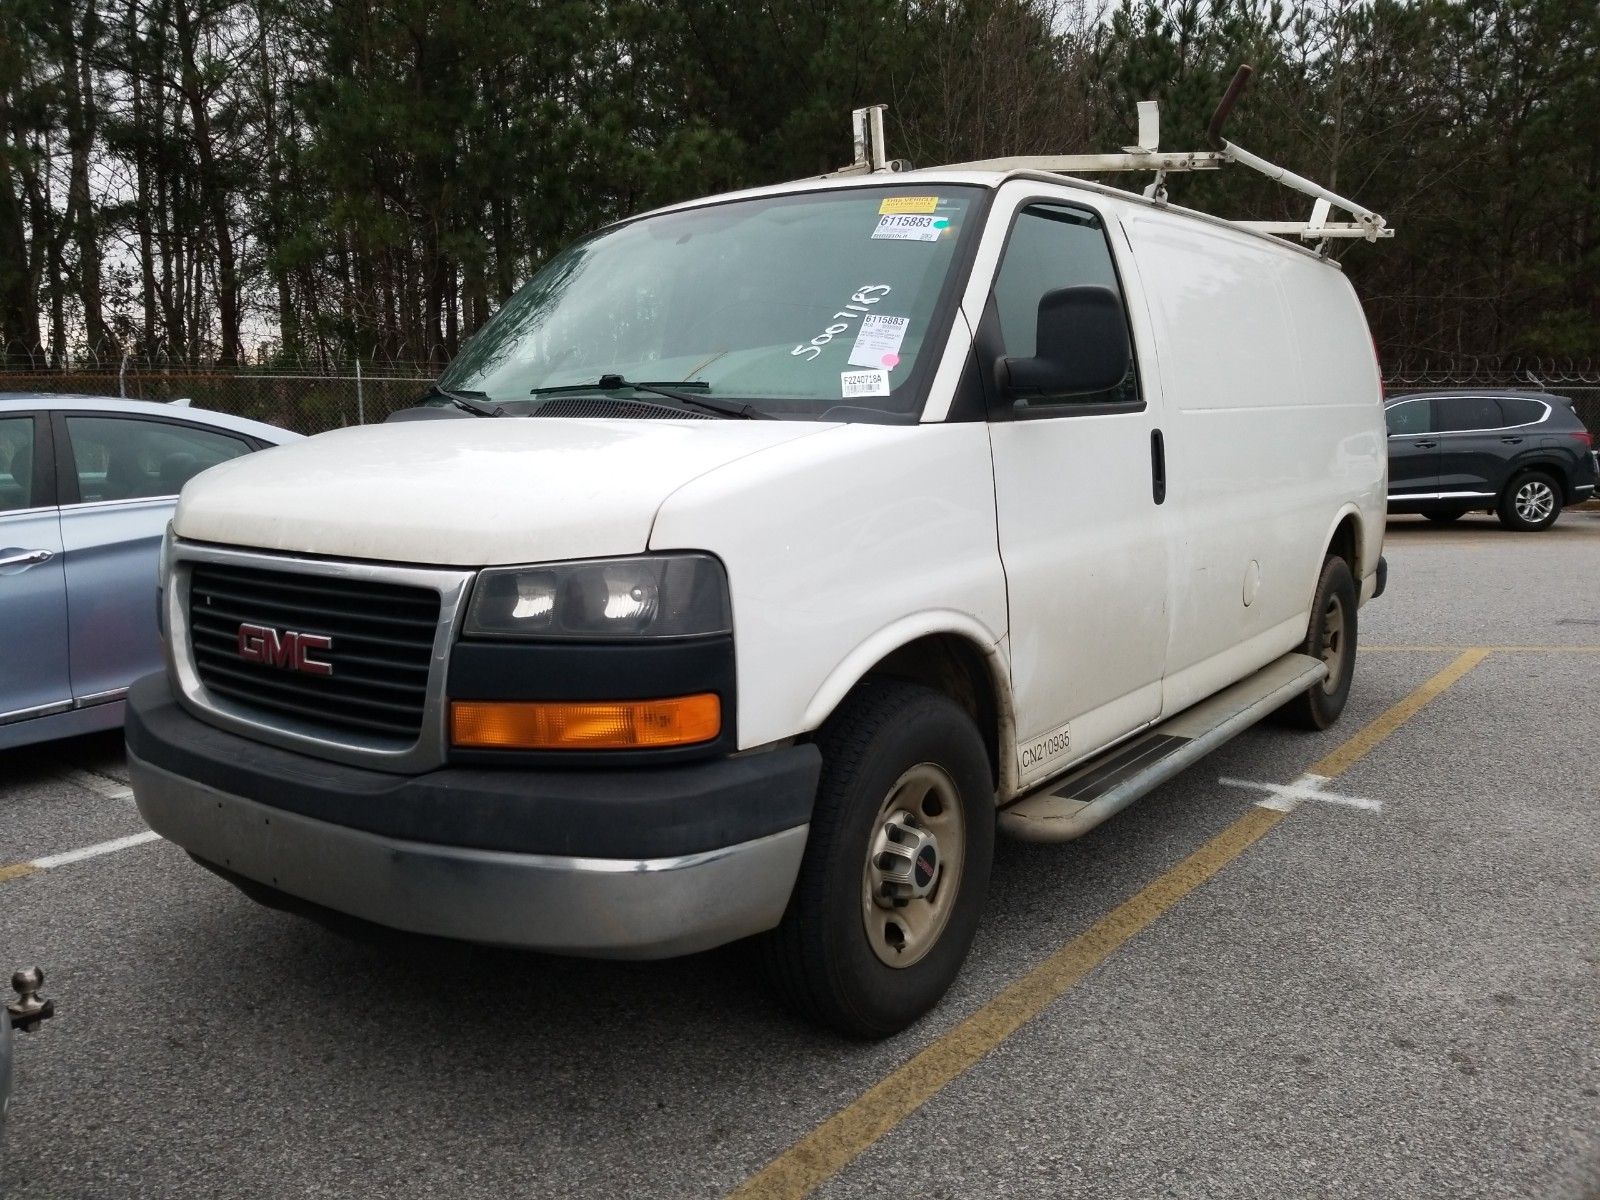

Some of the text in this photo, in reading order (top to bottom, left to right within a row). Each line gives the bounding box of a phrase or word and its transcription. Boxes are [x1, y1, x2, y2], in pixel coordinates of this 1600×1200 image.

[881, 216, 932, 227] 6115883
[866, 315, 904, 325] 6115883
[239, 622, 332, 676] GMC
[1022, 730, 1070, 768] CN210935
